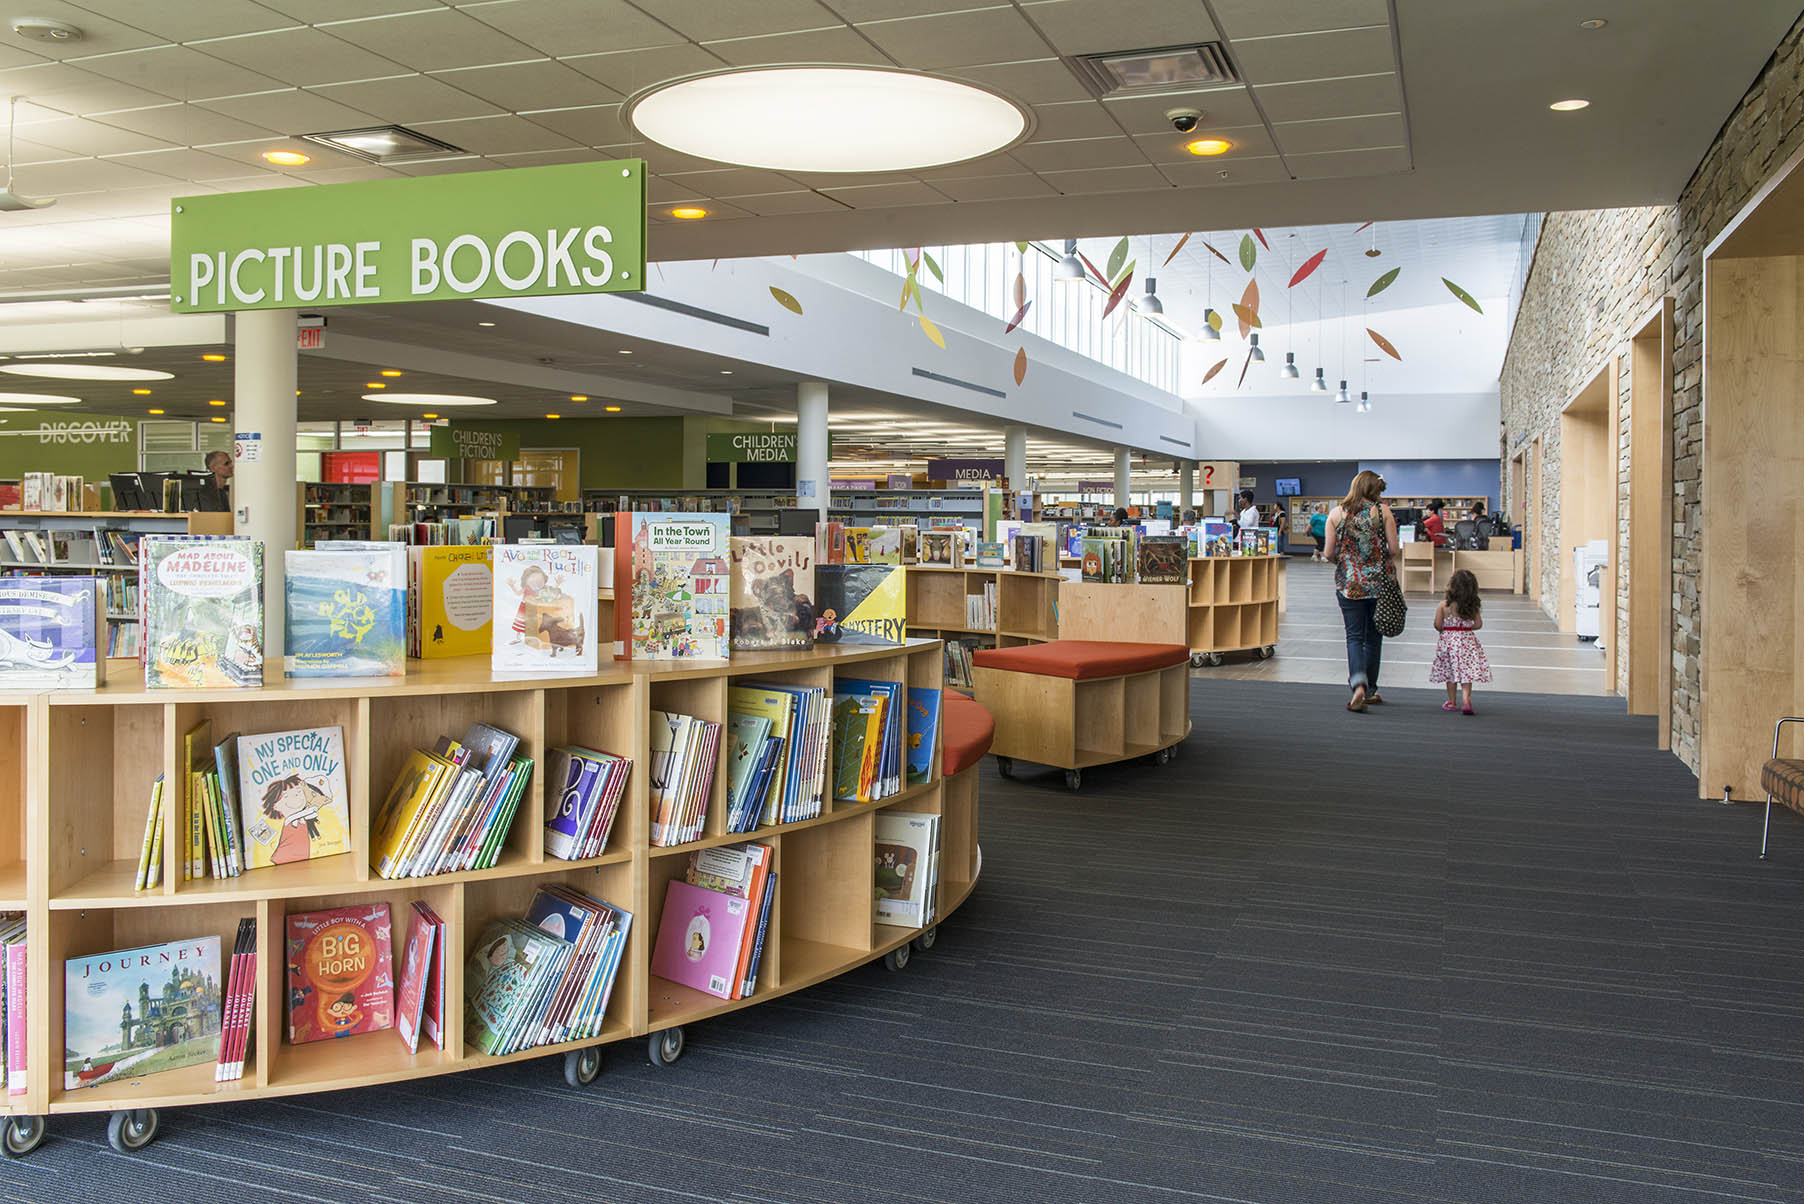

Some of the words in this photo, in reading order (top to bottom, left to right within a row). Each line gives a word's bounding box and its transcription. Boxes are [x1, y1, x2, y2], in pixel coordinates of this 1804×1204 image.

[190, 240, 381, 306] PICTURE
[411, 225, 614, 296] BOOKS
[301, 329, 320, 348] EXIT
[40, 421, 129, 444] DISCOVER
[452, 430, 503, 446] CHILDREN'S
[732, 435, 797, 449] CHILDREN'
[460, 444, 496, 459] FICTION
[746, 448, 788, 461] MEDIA
[955, 468, 991, 480] MEDIA
[654, 526, 664, 536] In
[666, 526, 682, 536] the
[683, 526, 710, 536] Town
[653, 537, 664, 545] All
[665, 537, 682, 545] Year
[177, 552, 200, 560] MAD
[203, 552, 235, 560] ABOUT
[166, 561, 247, 573] MADELINE
[334, 587, 368, 607] OLD
[330, 618, 377, 643] FLY
[254, 740, 274, 762] MY
[251, 760, 281, 785] ONE
[282, 757, 301, 771] AND
[303, 754, 339, 777] ONLY
[312, 920, 330, 936] LITTLE
[330, 917, 345, 925] BOY
[345, 917, 362, 926] WITH
[82, 946, 206, 979] JOURNEY
[318, 957, 366, 977] HORN
